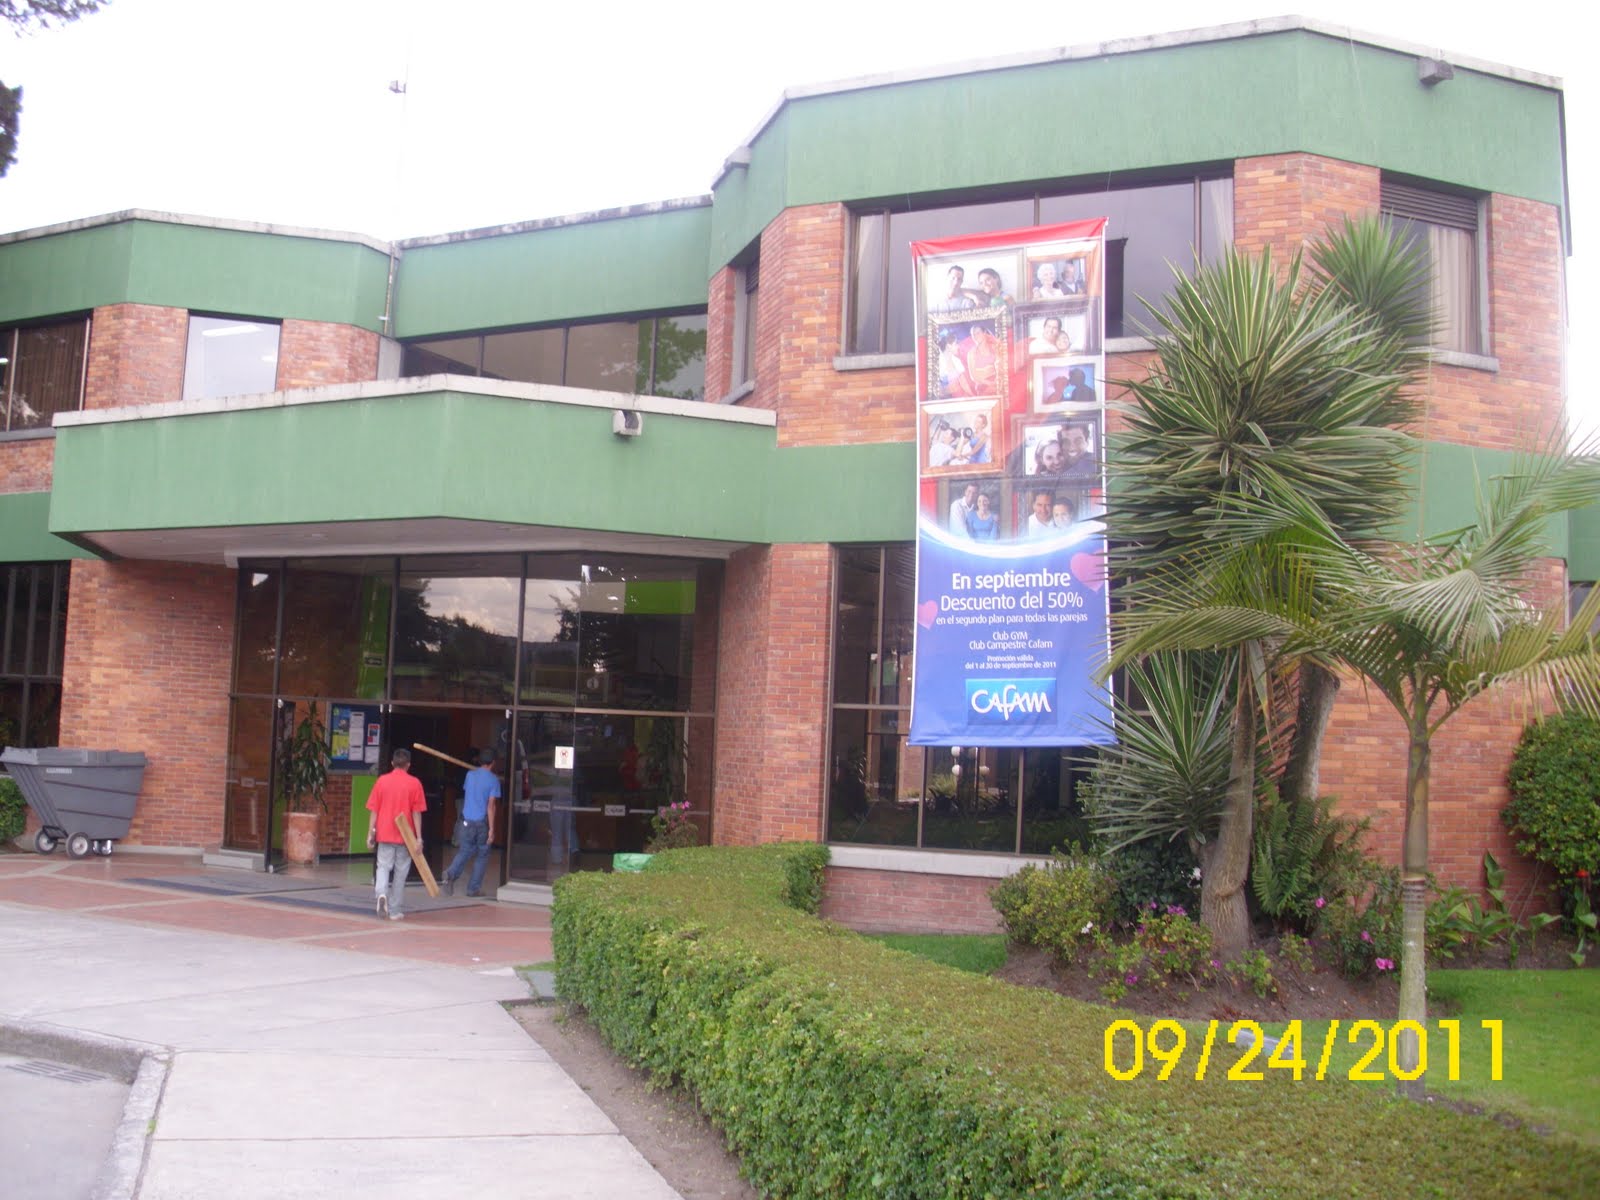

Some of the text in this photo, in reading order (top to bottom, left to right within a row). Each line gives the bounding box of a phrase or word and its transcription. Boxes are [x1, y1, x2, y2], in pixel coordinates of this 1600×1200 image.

[952, 568, 1071, 593] En septiembre
[941, 591, 1083, 611] Descuento del 50%
[936, 612, 1088, 626] en el segundo plan para todas las parejas
[992, 631, 1028, 641] Club GYM
[969, 638, 1053, 651] Club Campestre Cafam
[987, 654, 1016, 662] Promoción
[965, 661, 974, 669] del
[979, 661, 985, 669] al
[994, 661, 1001, 669] de
[1002, 661, 1033, 670] septiembre
[1034, 660, 1041, 669] de
[1042, 661, 1056, 669] 2011
